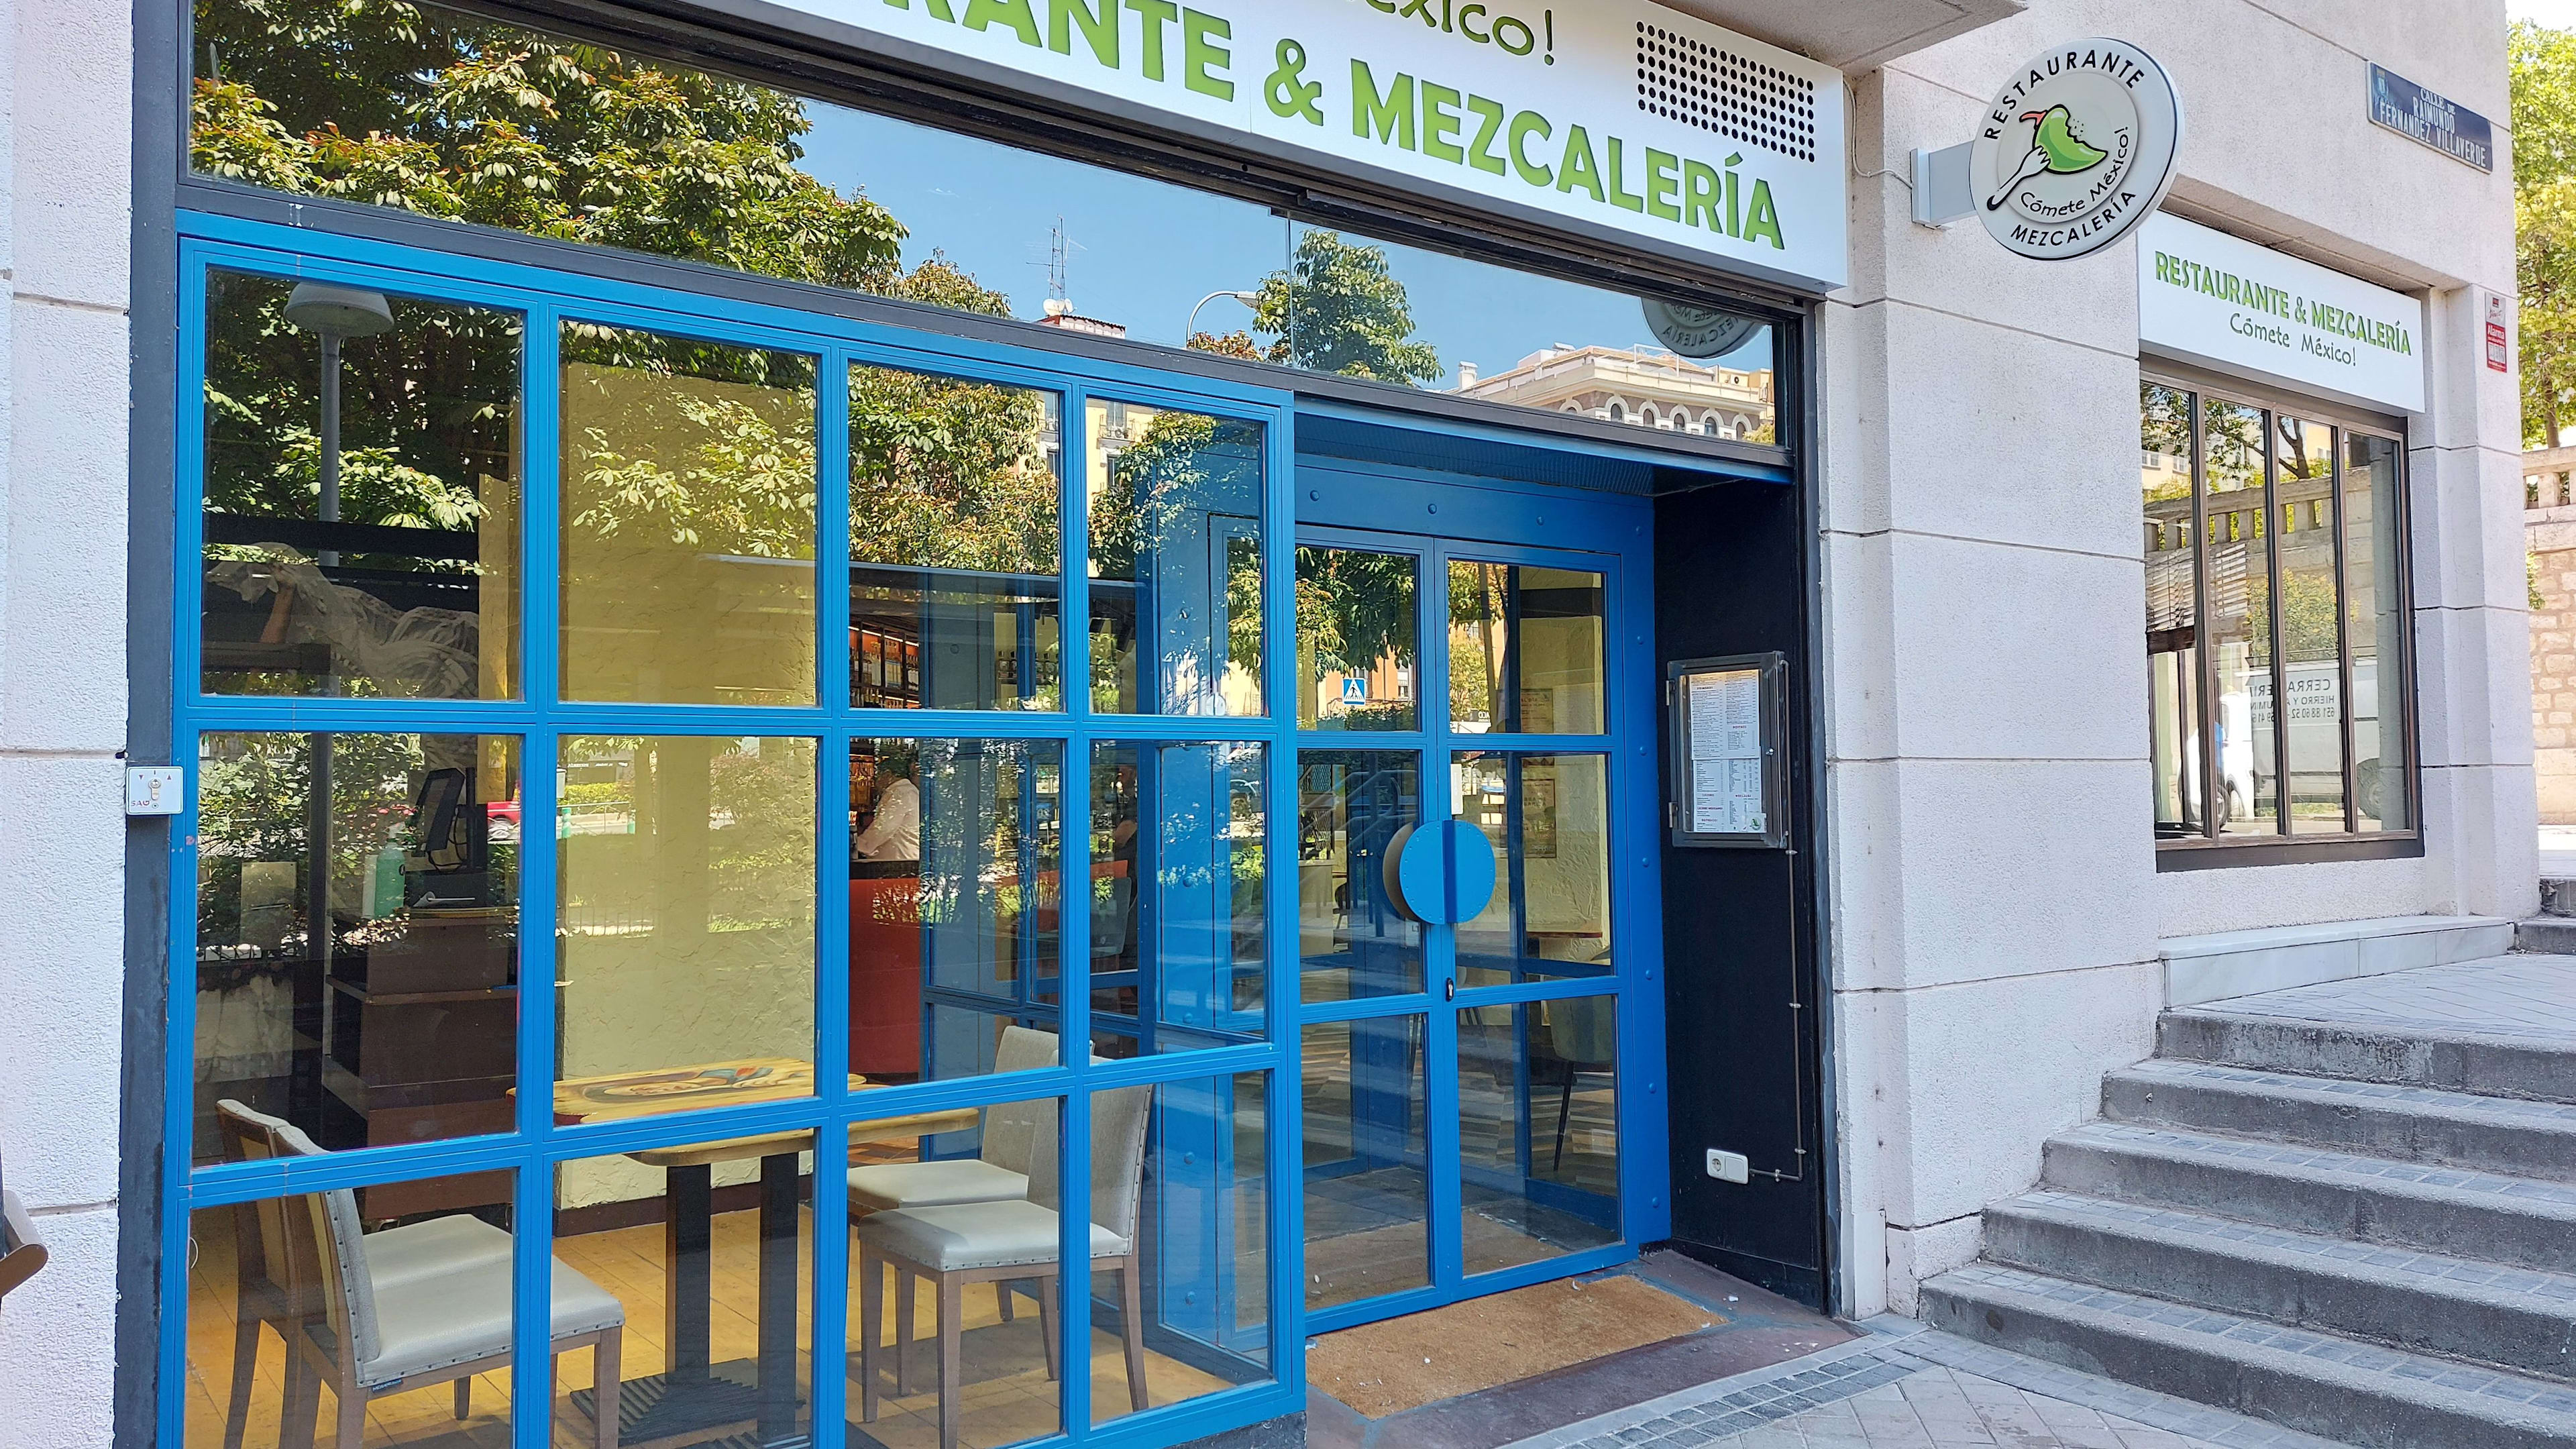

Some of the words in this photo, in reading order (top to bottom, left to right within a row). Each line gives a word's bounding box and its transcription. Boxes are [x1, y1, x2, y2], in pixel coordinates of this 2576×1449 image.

[1984, 49, 2145, 140] RESTAURANTE
[2412, 96, 2455, 134] RAIMUNDO
[2419, 88, 2445, 109] CALLE
[2447, 103, 2456, 114] DE
[1263, 38, 1324, 126] &
[1350, 58, 1785, 250] MEZCALERÍA
[2379, 102, 2431, 143] FERNANDEZ
[2436, 127, 2487, 167] VILLAVERDE
[2021, 191, 2086, 217] Cómete
[2090, 126, 2129, 203] México!
[2010, 191, 2136, 247] MEZCALERÍA
[2155, 250, 2290, 319] RESTAURANTE
[2294, 296, 2307, 324] &
[2311, 300, 2412, 356] MEZCALERÍA
[2230, 313, 2290, 348] Cómete
[2301, 333, 2357, 367] México!
